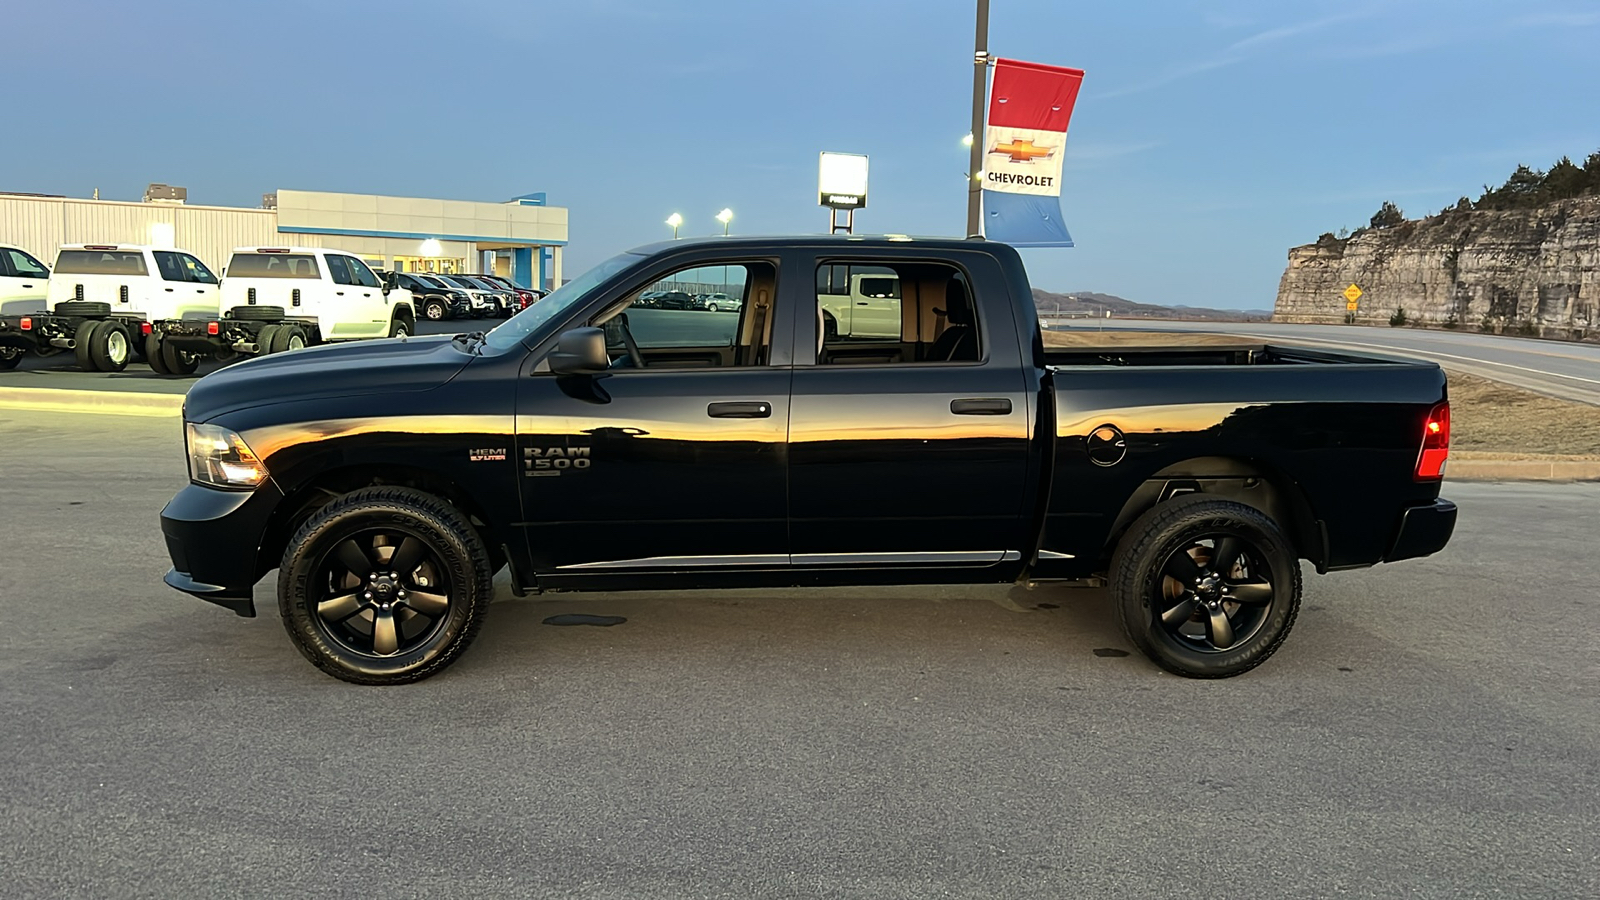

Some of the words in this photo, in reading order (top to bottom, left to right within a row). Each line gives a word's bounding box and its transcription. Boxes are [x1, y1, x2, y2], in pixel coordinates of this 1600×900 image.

[988, 171, 1053, 187] CHEVROLET
[469, 448, 506, 456] HEMI
[524, 447, 590, 457] RAM
[524, 458, 590, 469] 1500
